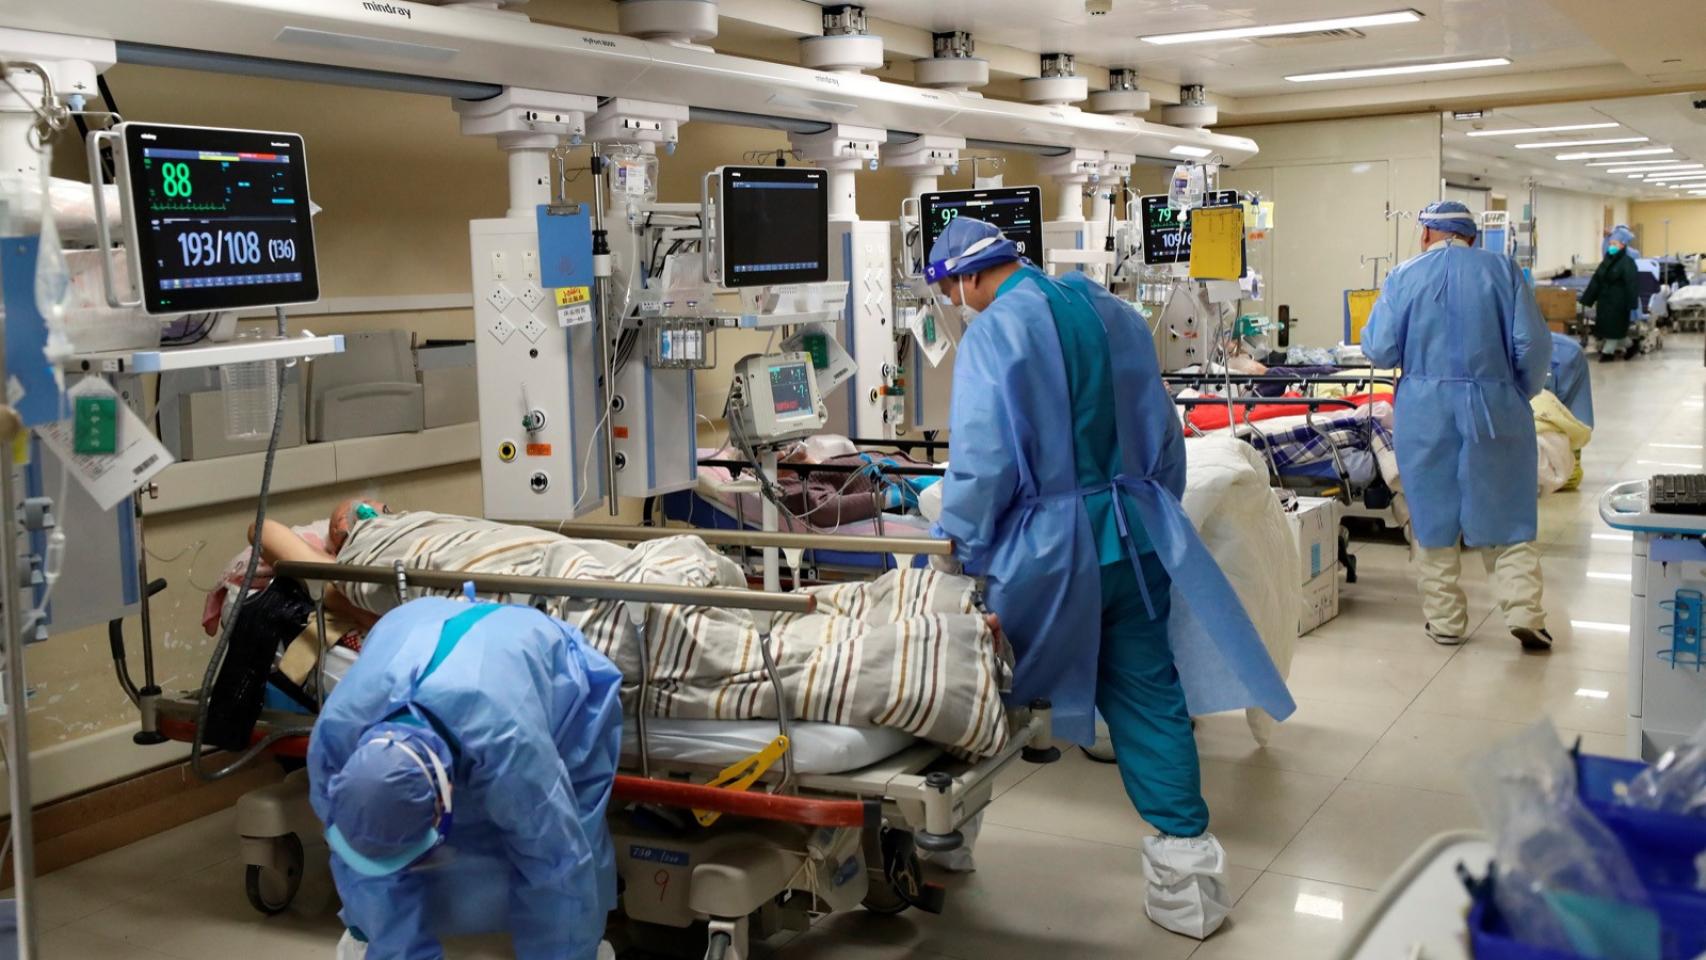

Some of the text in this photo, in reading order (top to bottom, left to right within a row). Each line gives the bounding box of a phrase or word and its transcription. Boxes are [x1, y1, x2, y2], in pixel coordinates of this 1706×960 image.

[362, 1, 411, 19] mindray
[161, 162, 192, 197] 88
[1157, 208, 1172, 222] 79
[177, 229, 296, 267] 193/108 (136)
[654, 869, 670, 903] 9
